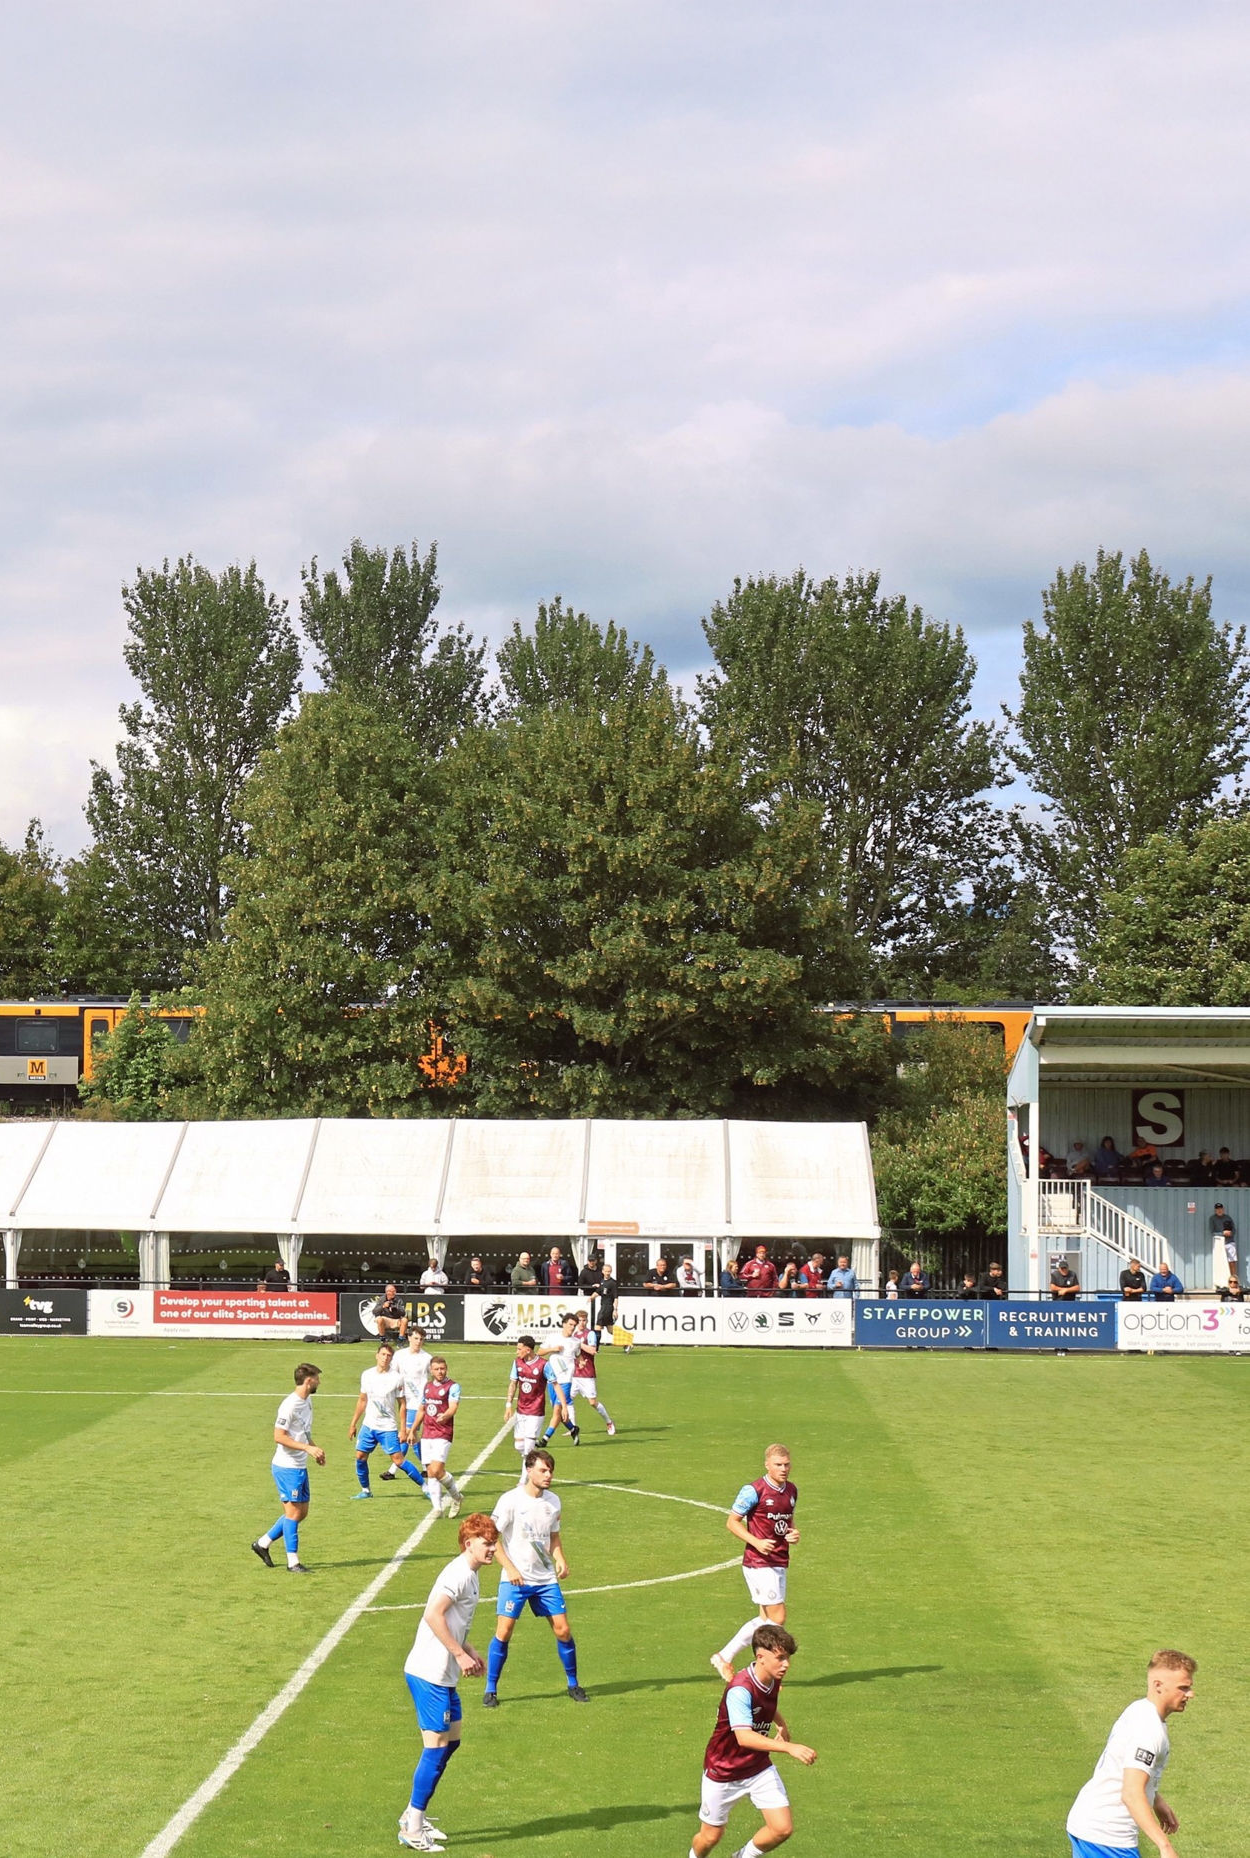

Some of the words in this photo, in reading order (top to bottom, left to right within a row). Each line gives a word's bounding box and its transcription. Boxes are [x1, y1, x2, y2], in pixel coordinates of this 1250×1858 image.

[30, 1061, 44, 1074] M
[1135, 1091, 1184, 1146] S
[29, 1298, 53, 1314] tvg
[159, 1296, 200, 1308] Develop
[201, 1299, 223, 1309] your
[225, 1297, 266, 1309] sporting
[267, 1297, 297, 1308] talent
[298, 1298, 310, 1308] at
[159, 1310, 178, 1319] one
[180, 1308, 193, 1319] of
[193, 1310, 211, 1320] our
[212, 1308, 235, 1320] elite
[236, 1309, 269, 1322] Sports
[270, 1309, 331, 1321] Academies.
[621, 1308, 717, 1333] ulman
[862, 1307, 984, 1321] STAFFPOWER
[998, 1311, 1109, 1324] RECRUITMENT
[1123, 1307, 1220, 1336] option3
[895, 1327, 951, 1339] GROUP
[1008, 1326, 1019, 1338] &
[1025, 1326, 1099, 1338] TRAINING
